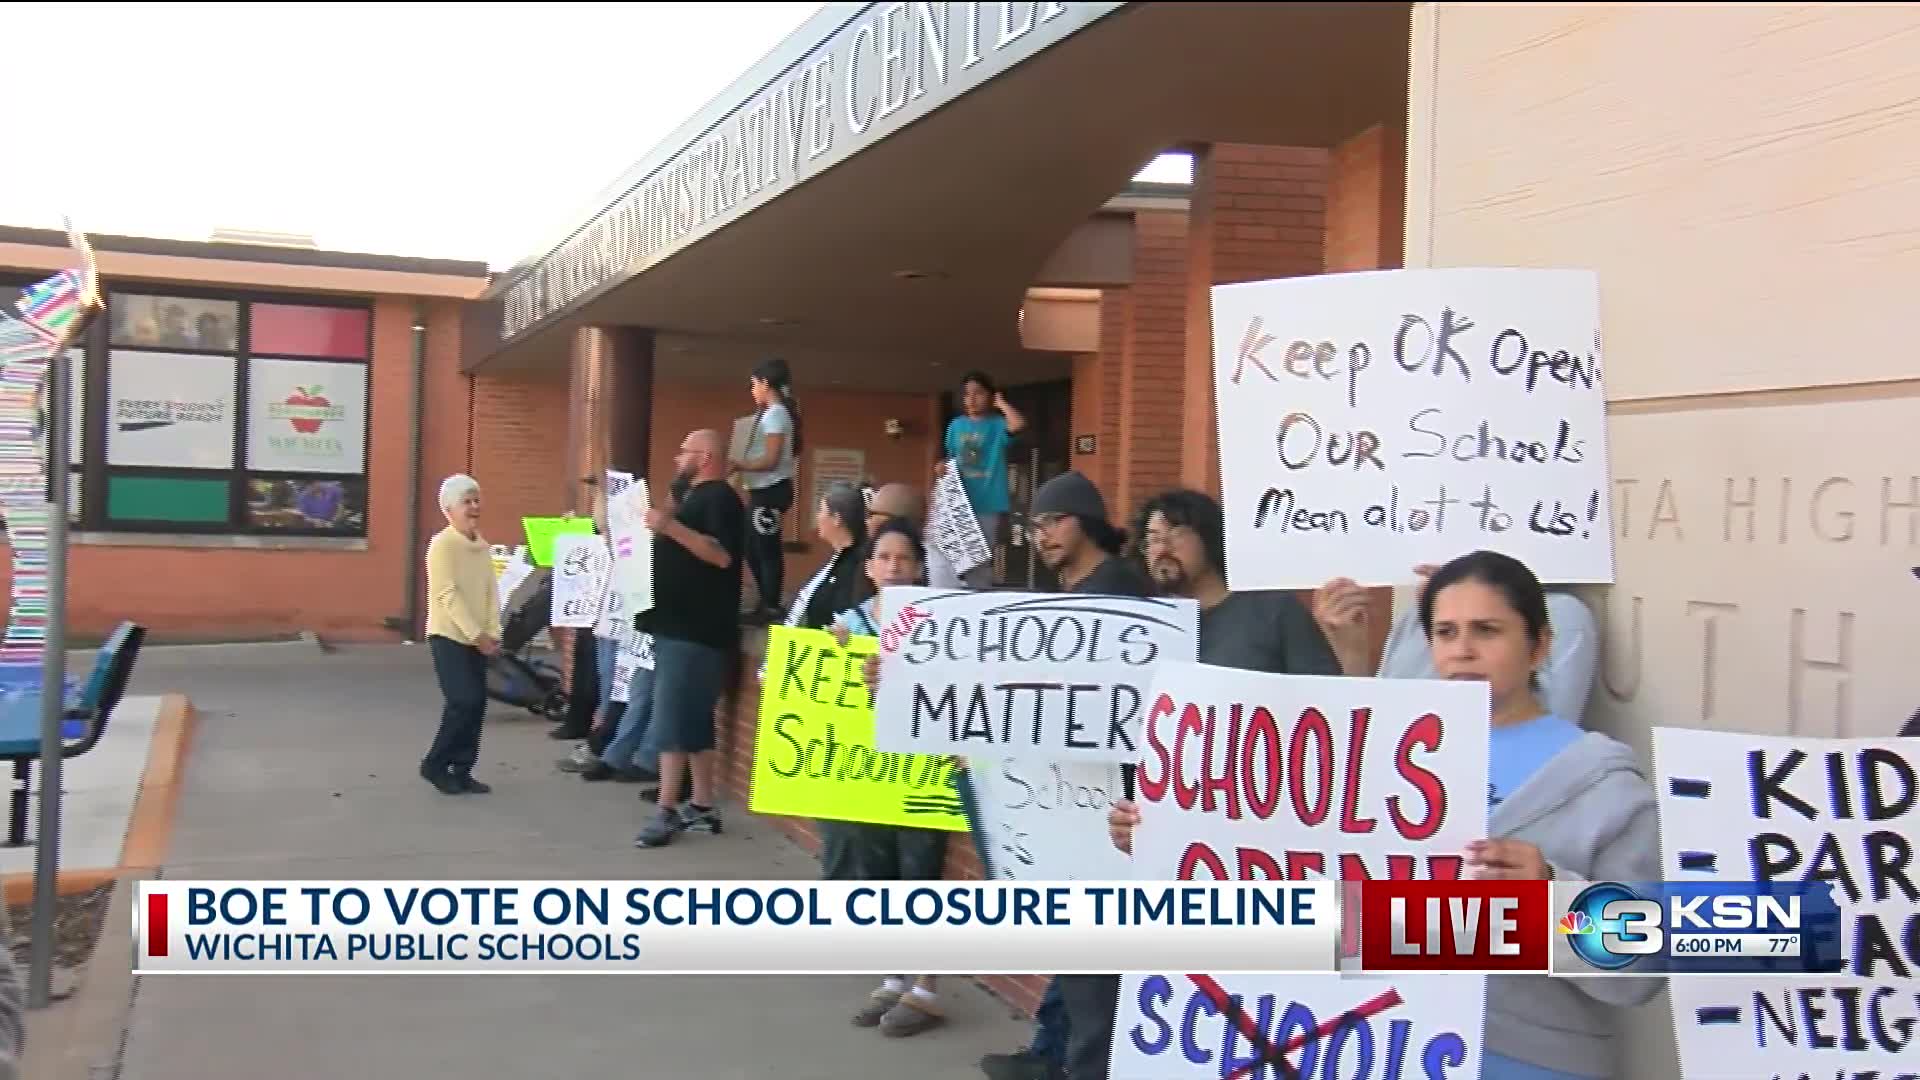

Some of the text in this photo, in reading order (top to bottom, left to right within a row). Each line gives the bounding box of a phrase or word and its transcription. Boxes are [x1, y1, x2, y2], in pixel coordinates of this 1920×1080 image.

[602, 54, 836, 284] ADMINISTRATIVE
[845, 2, 1068, 135] CENT
[1231, 314, 1371, 408] Keep
[1393, 304, 1476, 383] OK
[116, 399, 162, 411] EVERY
[1254, 486, 1349, 535] Mean
[778, 639, 877, 711] KEE
[904, 614, 1160, 666] SCHOOLS
[910, 681, 1142, 751] MATTER
[1136, 692, 1449, 841] SCHOOLS
